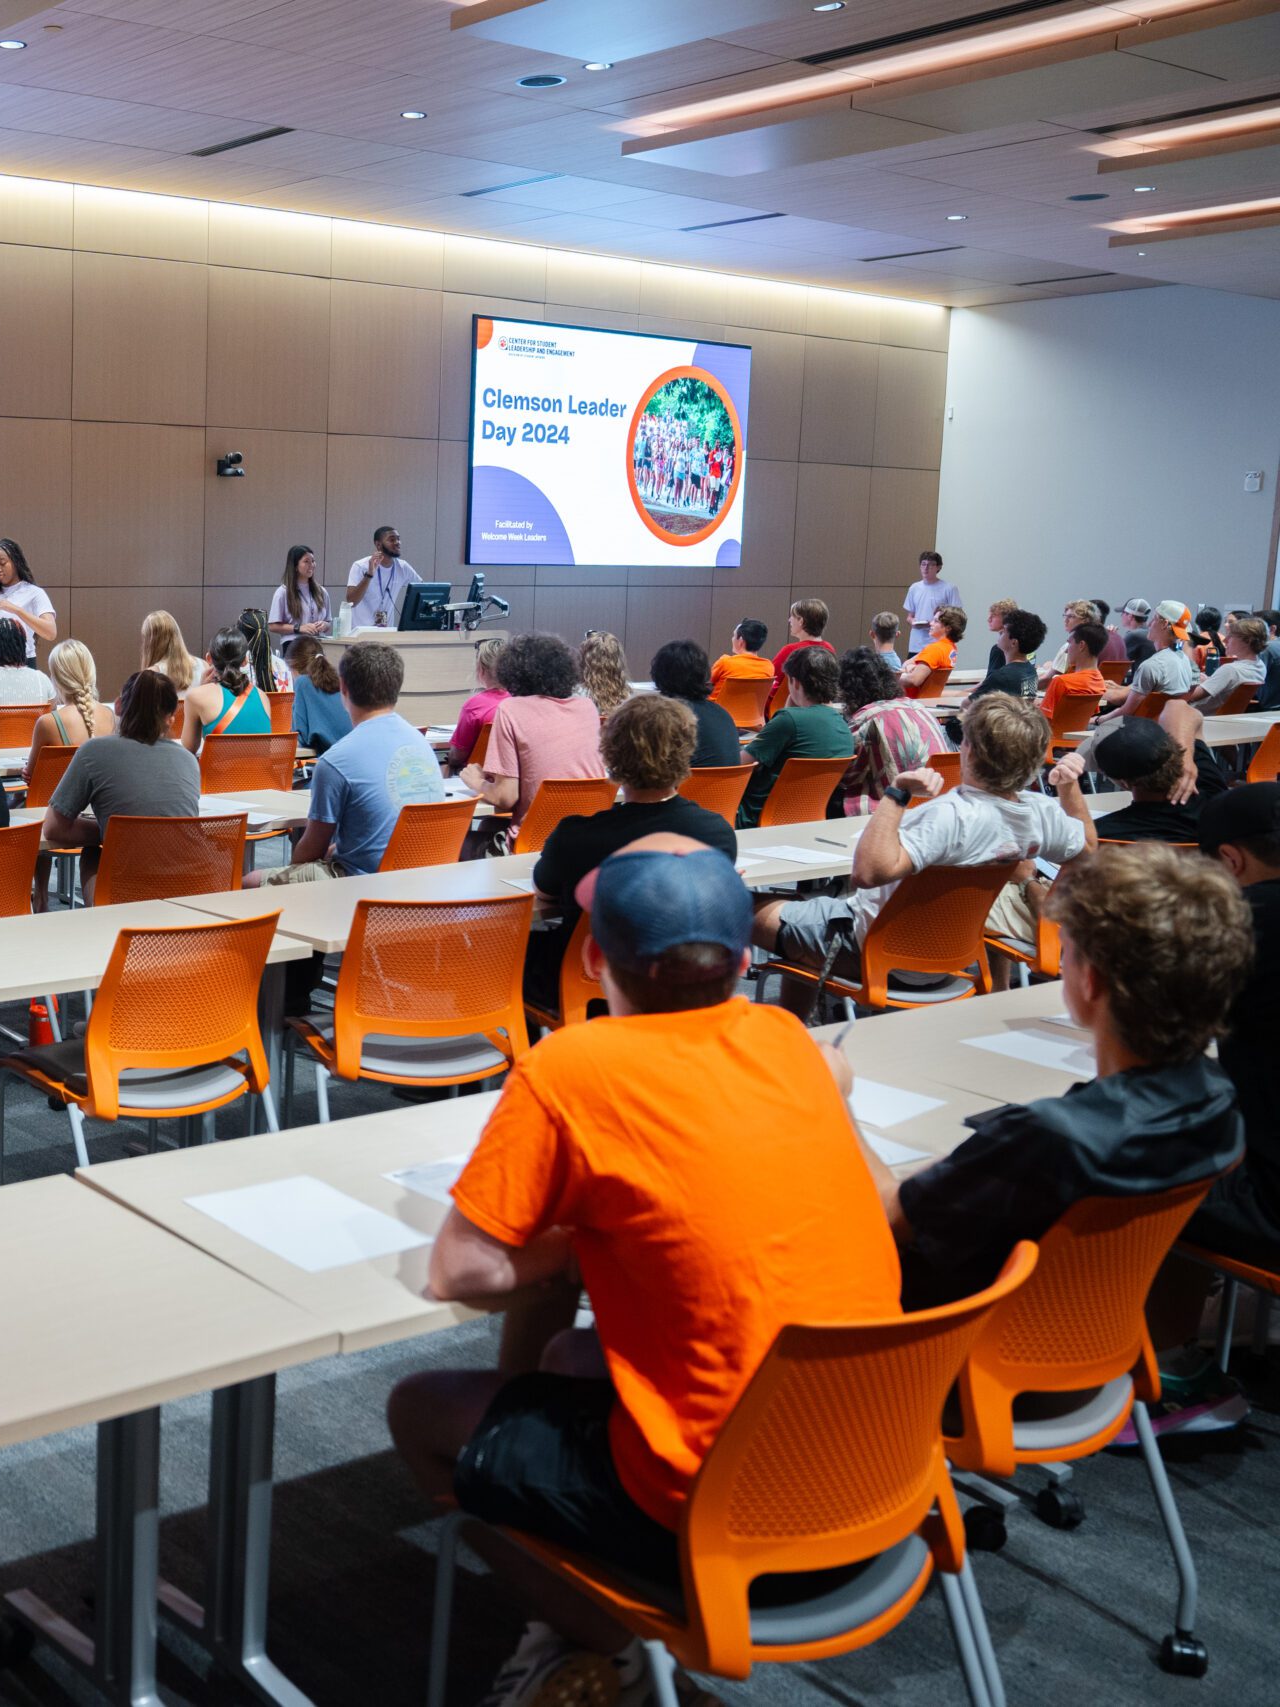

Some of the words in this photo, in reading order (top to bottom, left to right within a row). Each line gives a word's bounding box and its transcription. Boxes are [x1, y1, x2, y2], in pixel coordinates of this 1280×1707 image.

[536, 340, 557, 348] STUDENT
[509, 345, 536, 353] LEADERSHIP
[536, 347, 545, 355] AND
[546, 348, 575, 357] ENGAGEMENT
[482, 387, 563, 413] Clemson
[568, 395, 627, 418] Leader
[482, 420, 517, 447] Day
[521, 422, 570, 445] 2024
[495, 519, 525, 529] Facilitated
[525, 520, 534, 531] by
[481, 532, 507, 541] Welcome
[507, 532, 524, 541] Week
[524, 533, 547, 542] Leaders
